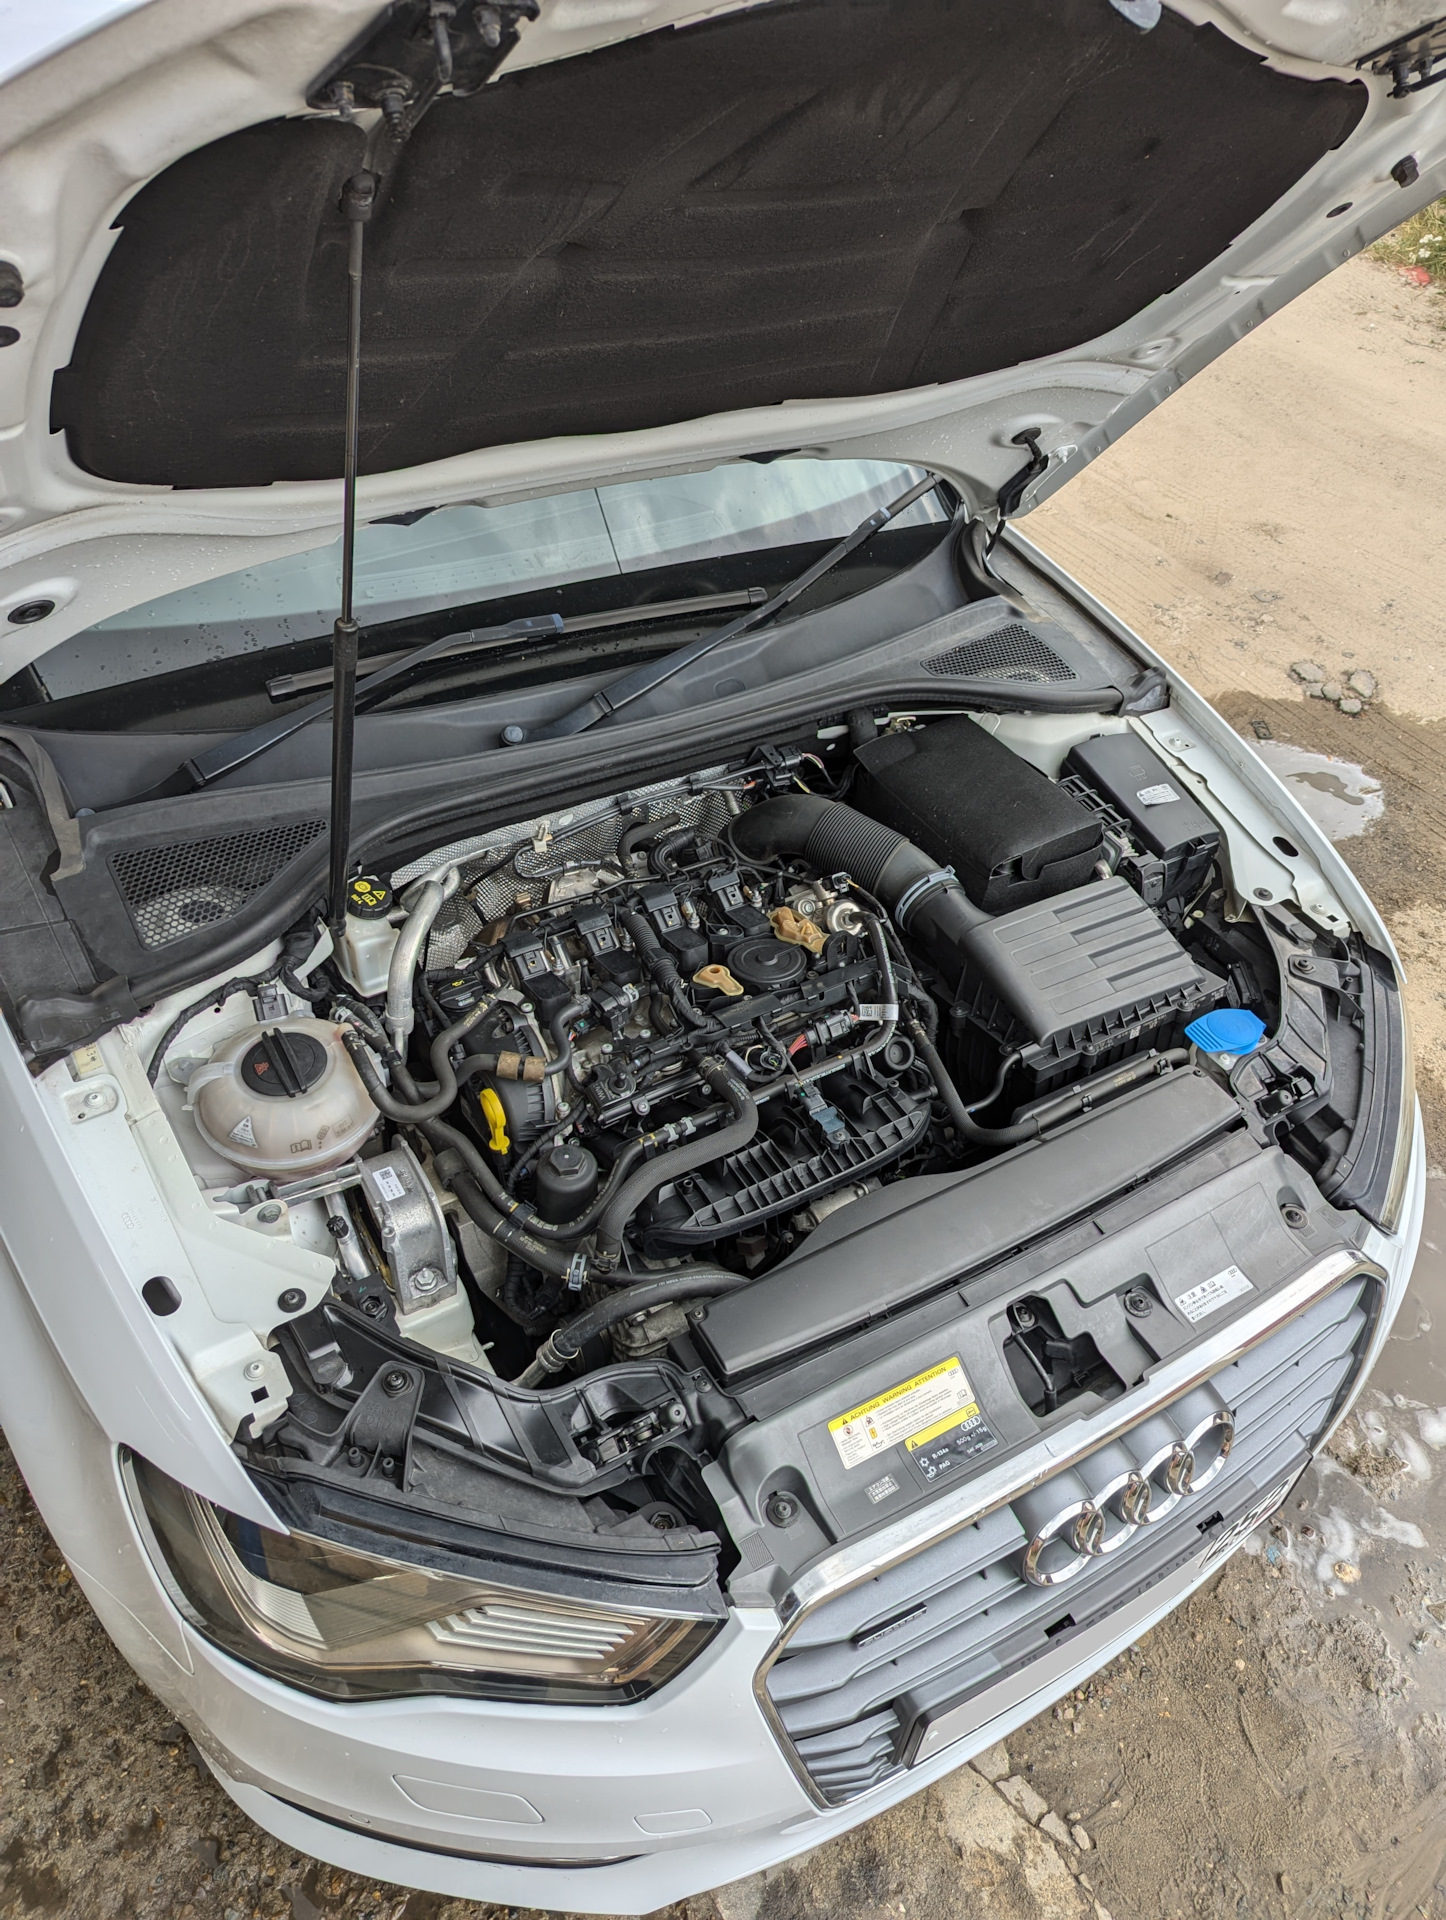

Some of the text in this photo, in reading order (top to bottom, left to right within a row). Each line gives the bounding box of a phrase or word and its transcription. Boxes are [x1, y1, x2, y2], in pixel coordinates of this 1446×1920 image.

[850, 1367, 947, 1422] ACHTUNG WARNING ATTENTION
[938, 1460, 951, 1470] PAG
[1204, 1478, 1290, 1563] 252
